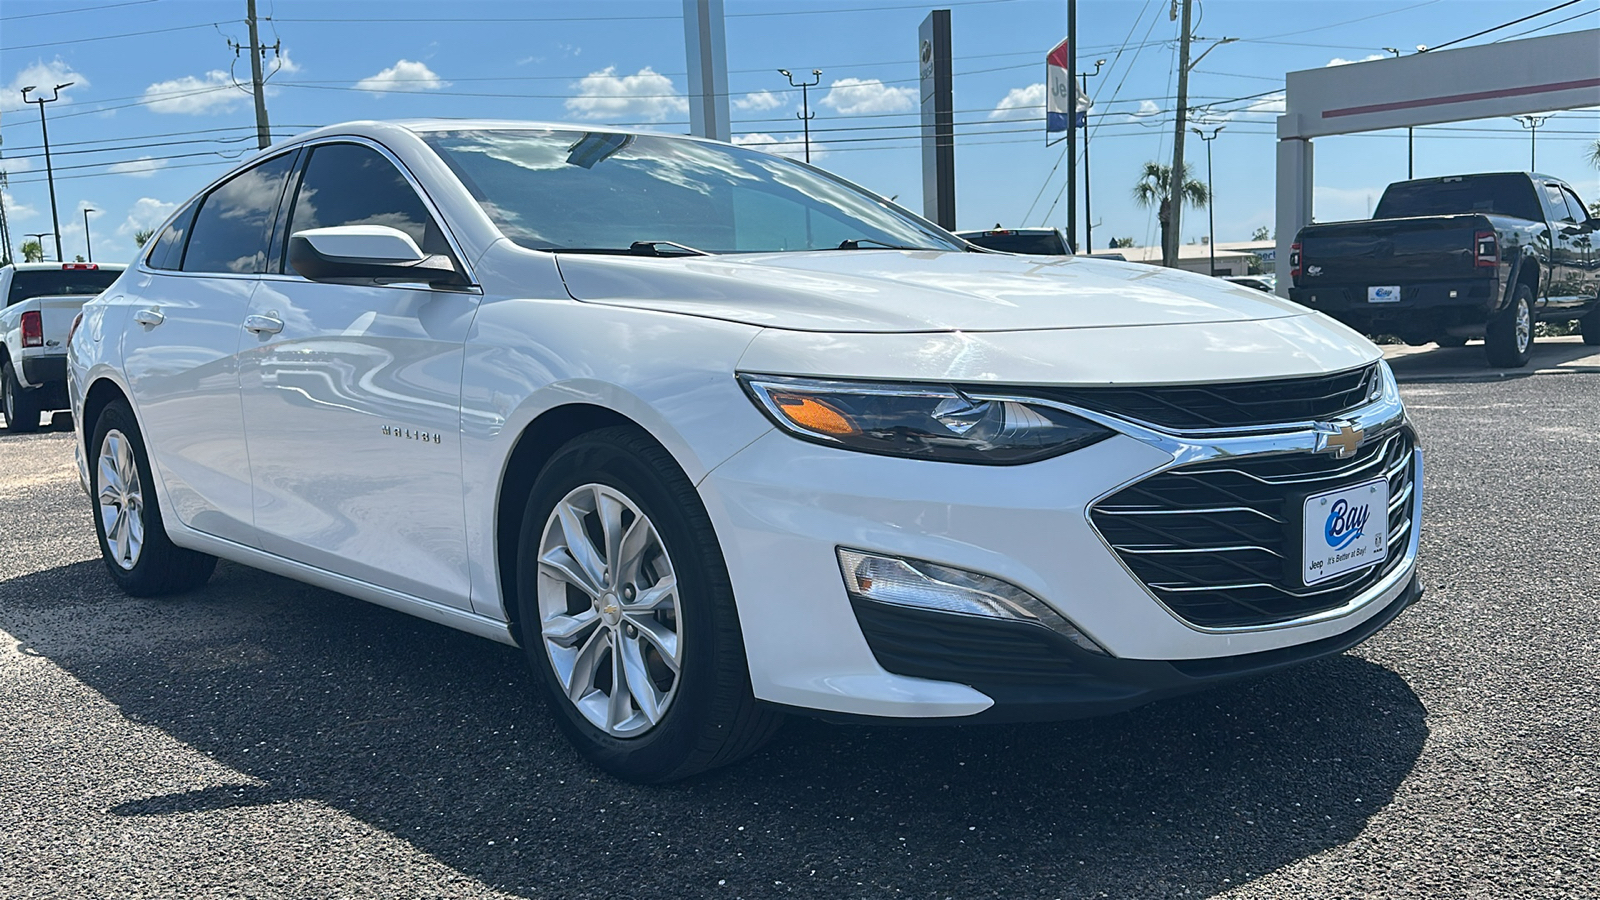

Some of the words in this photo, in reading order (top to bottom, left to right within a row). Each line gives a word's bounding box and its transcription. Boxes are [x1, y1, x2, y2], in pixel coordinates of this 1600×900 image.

[381, 424, 441, 444] MALIBU
[1327, 498, 1371, 541] Bay
[1327, 555, 1336, 565] It's
[1335, 552, 1351, 563] Better
[1350, 548, 1356, 558] at
[1356, 545, 1367, 557] Bay!
[1309, 560, 1324, 571] Jeep
